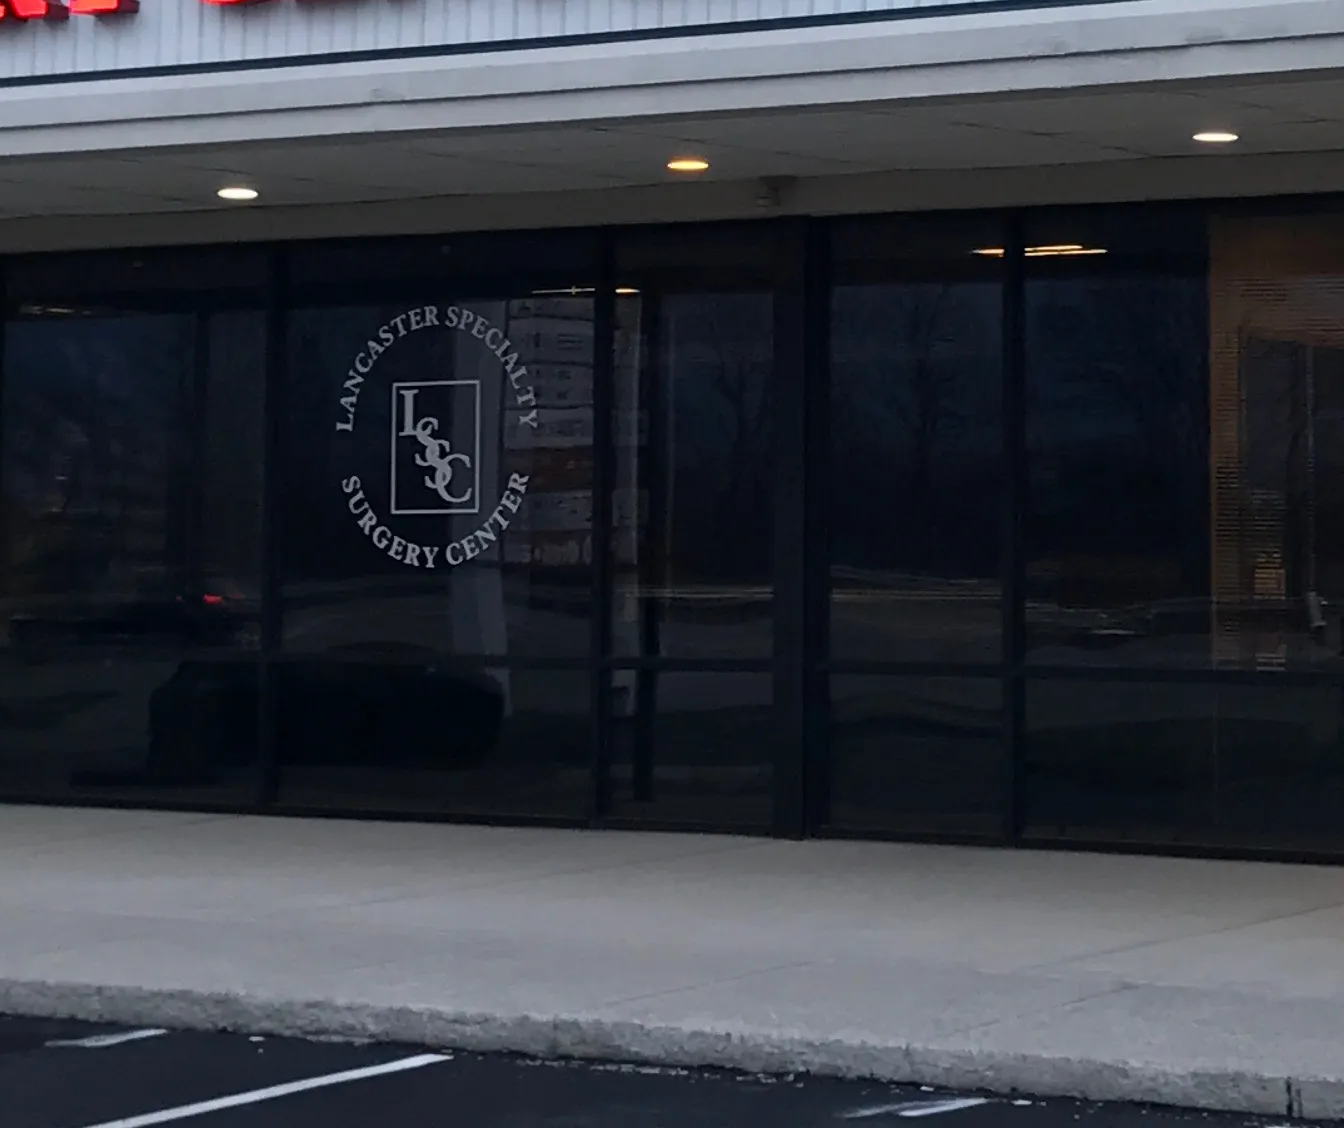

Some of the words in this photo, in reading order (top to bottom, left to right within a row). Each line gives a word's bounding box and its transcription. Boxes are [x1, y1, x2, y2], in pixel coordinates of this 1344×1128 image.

[336, 305, 440, 432] LANCASTER
[444, 306, 538, 428] SPECIALTY
[341, 475, 439, 569] SURGERY
[445, 472, 530, 566] CENTER
